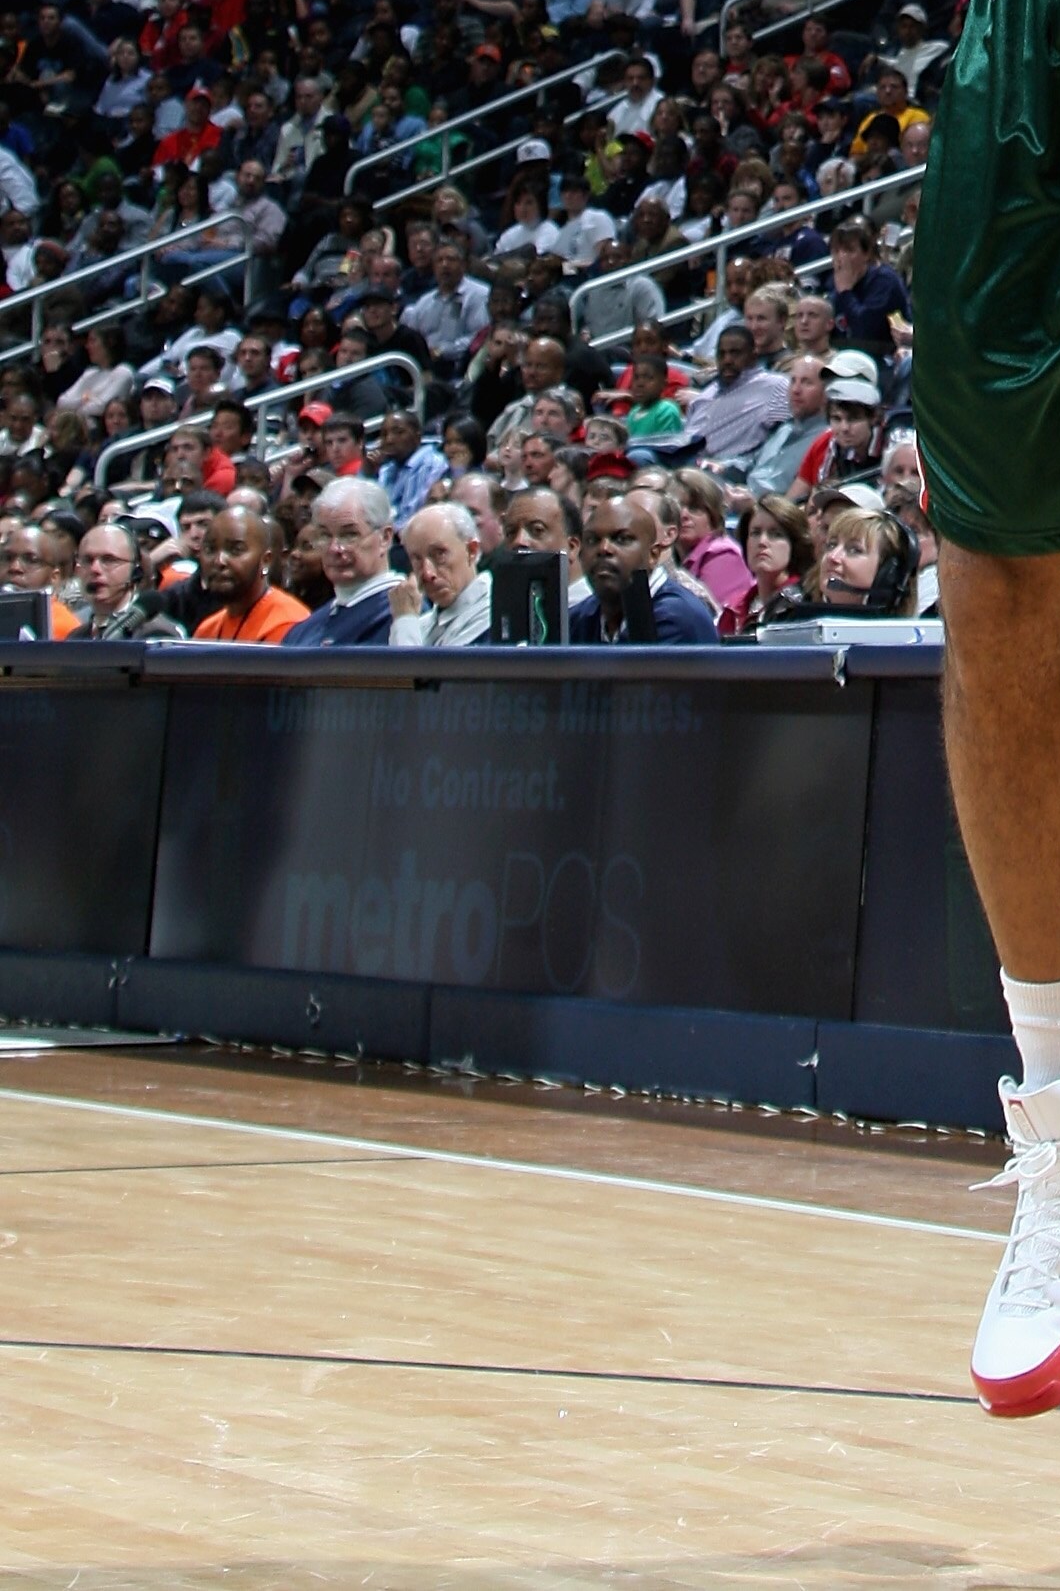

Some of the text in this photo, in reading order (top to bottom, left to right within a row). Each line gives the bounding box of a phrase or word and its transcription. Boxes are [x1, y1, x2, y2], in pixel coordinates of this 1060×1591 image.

[417, 682, 547, 733] Wireless
[559, 680, 702, 733] Minutes.
[371, 754, 566, 809] No Contract.
